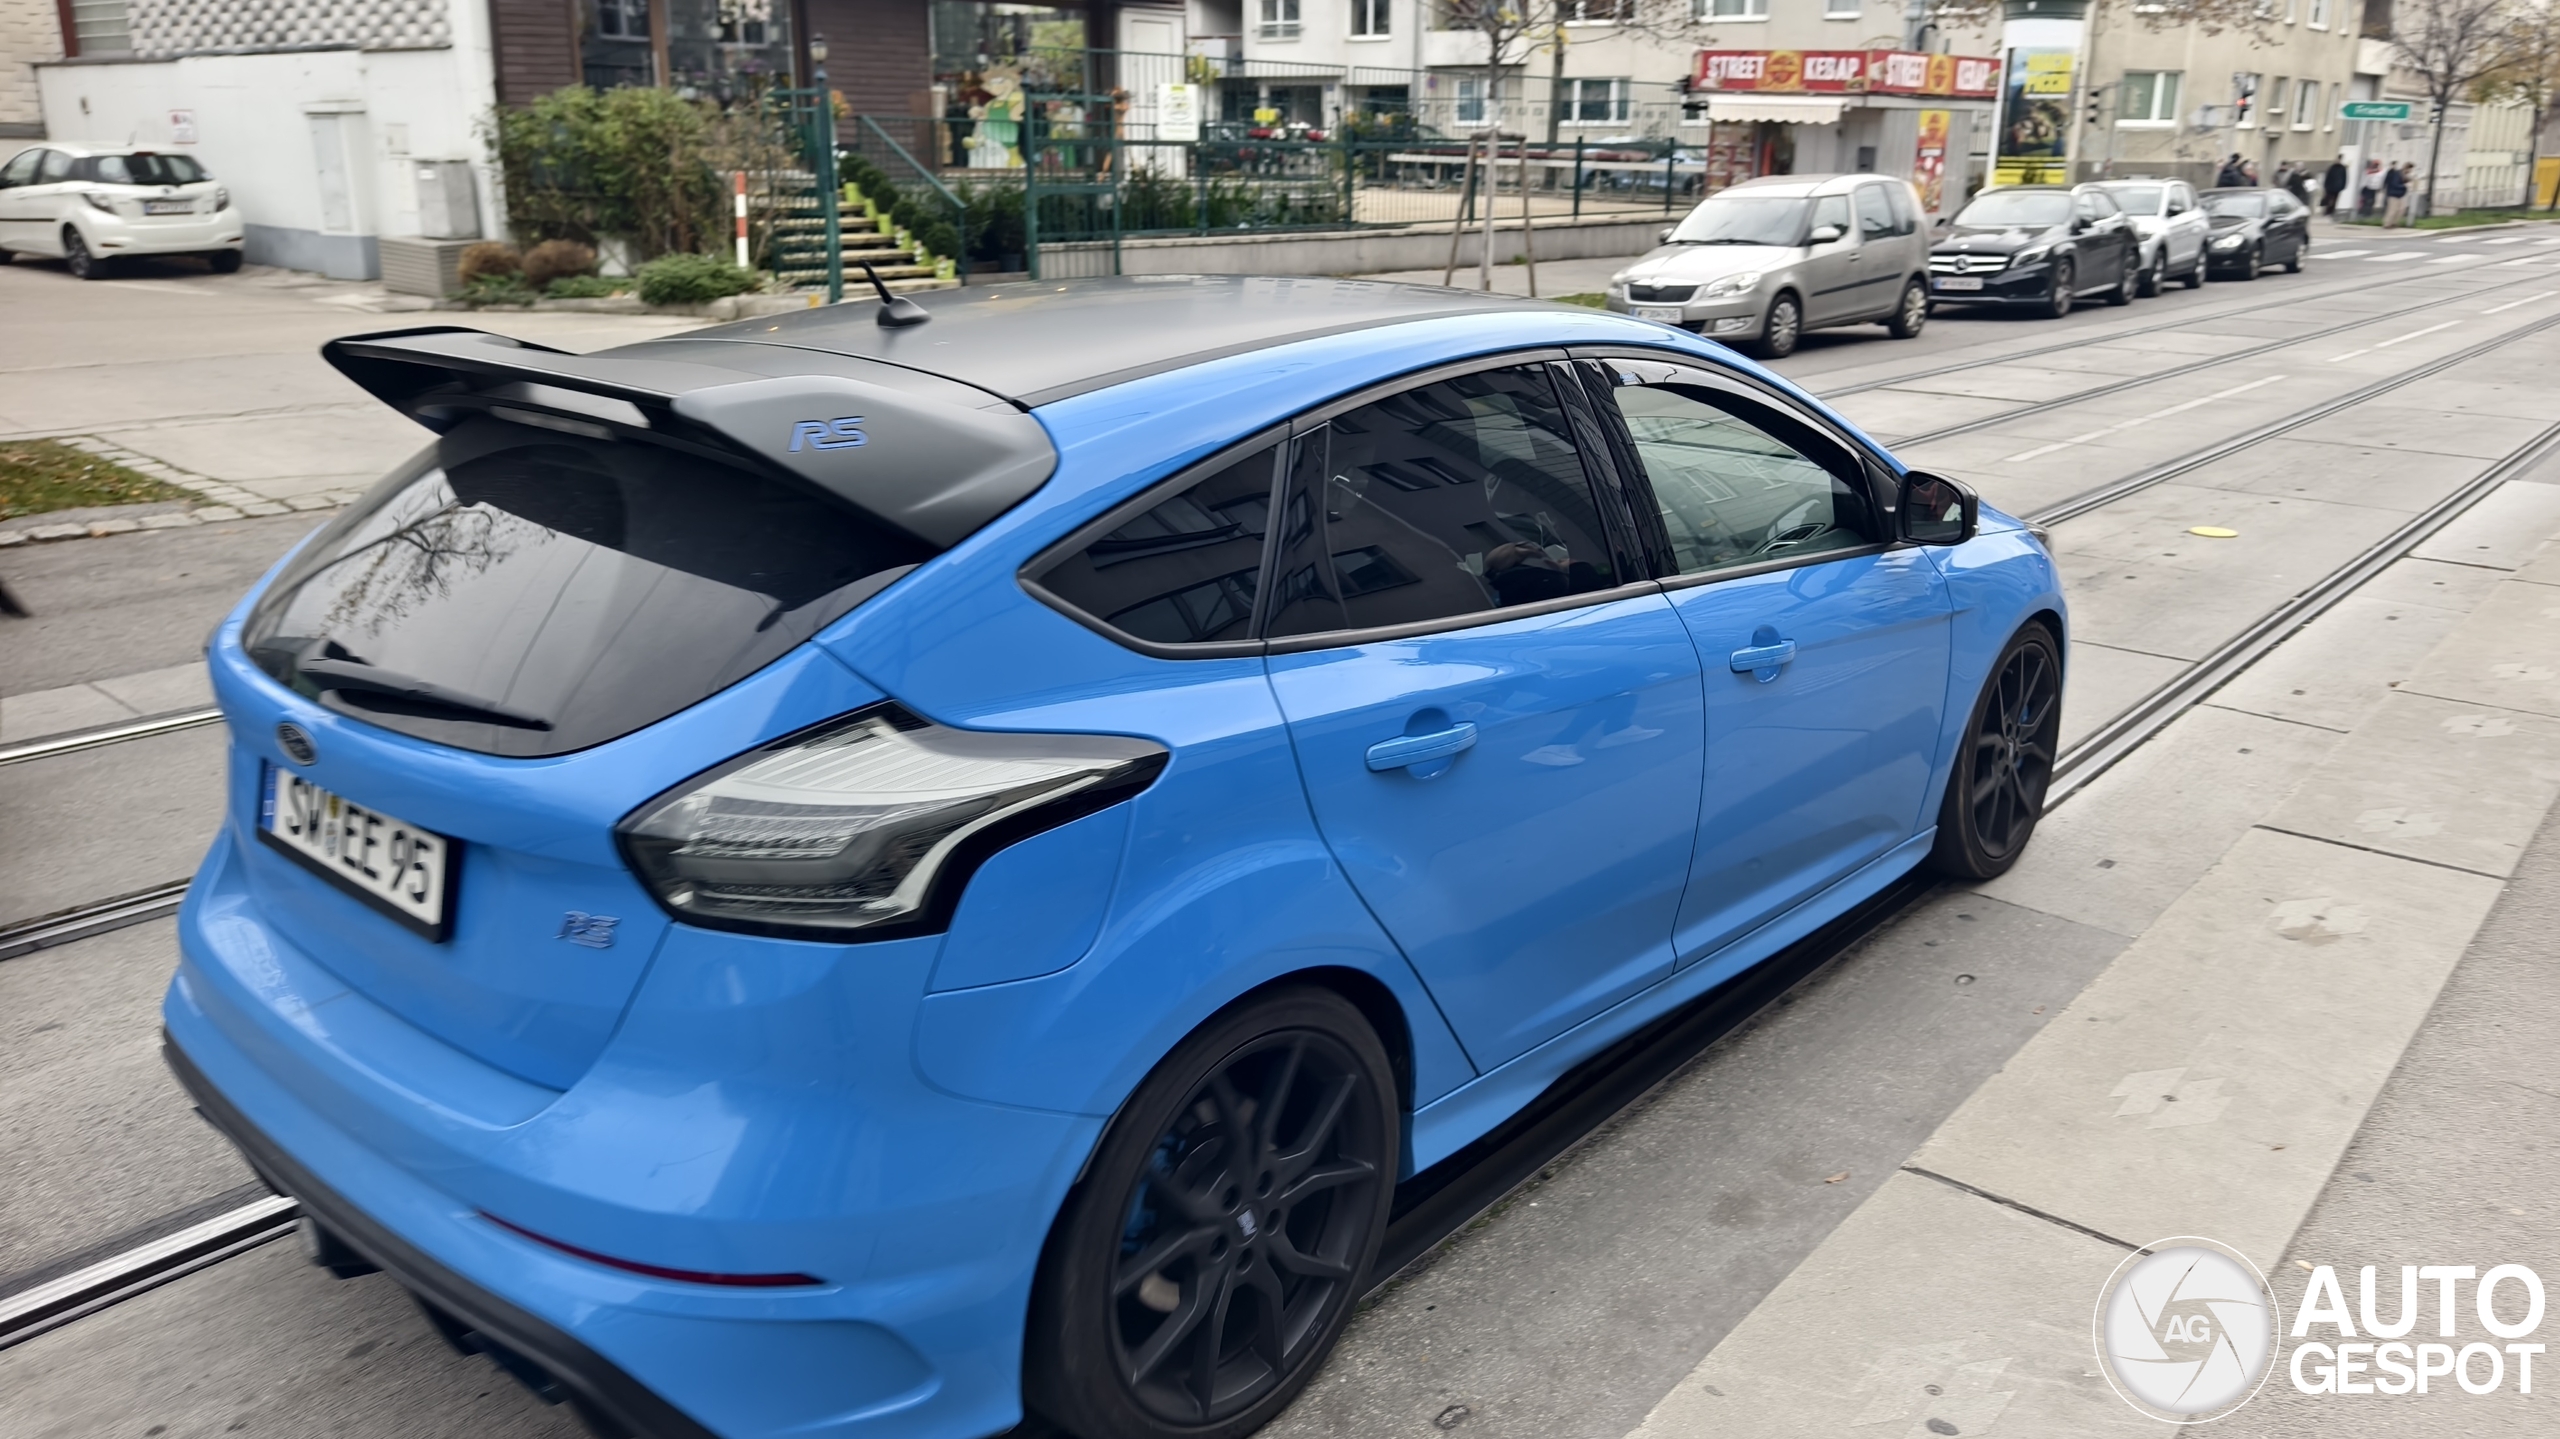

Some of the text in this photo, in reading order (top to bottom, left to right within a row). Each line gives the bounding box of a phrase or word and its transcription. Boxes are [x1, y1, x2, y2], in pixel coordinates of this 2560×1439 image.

[1707, 55, 1861, 81] STREET KEBAP
[788, 416, 868, 452] RS
[340, 803, 384, 881] EE
[390, 829, 432, 905] 95
[553, 910, 621, 949] RS
